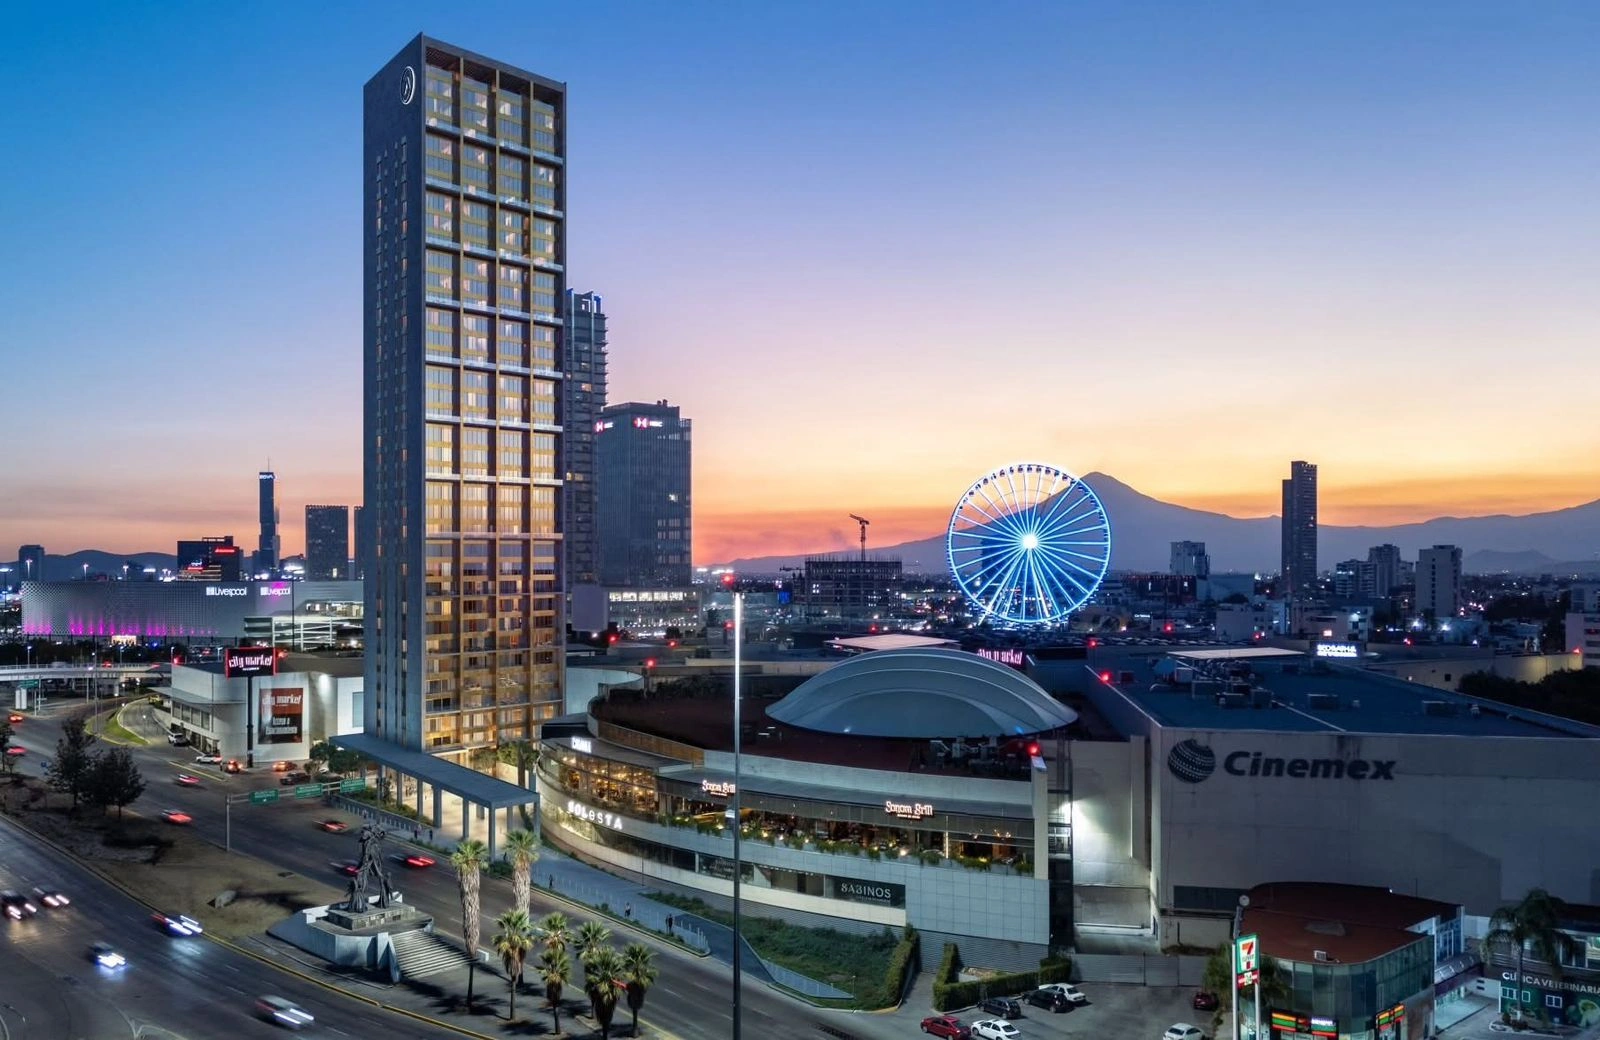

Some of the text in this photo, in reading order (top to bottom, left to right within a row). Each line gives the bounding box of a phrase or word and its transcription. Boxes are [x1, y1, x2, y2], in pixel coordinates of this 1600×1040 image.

[214, 587, 247, 597] Liverpool
[267, 587, 291, 597] Liverpool
[228, 654, 273, 668] city market
[276, 694, 302, 705] market
[1223, 750, 1397, 780] Cinemex
[913, 803, 933, 816] Grill
[1502, 971, 1541, 985] CLÍICA
